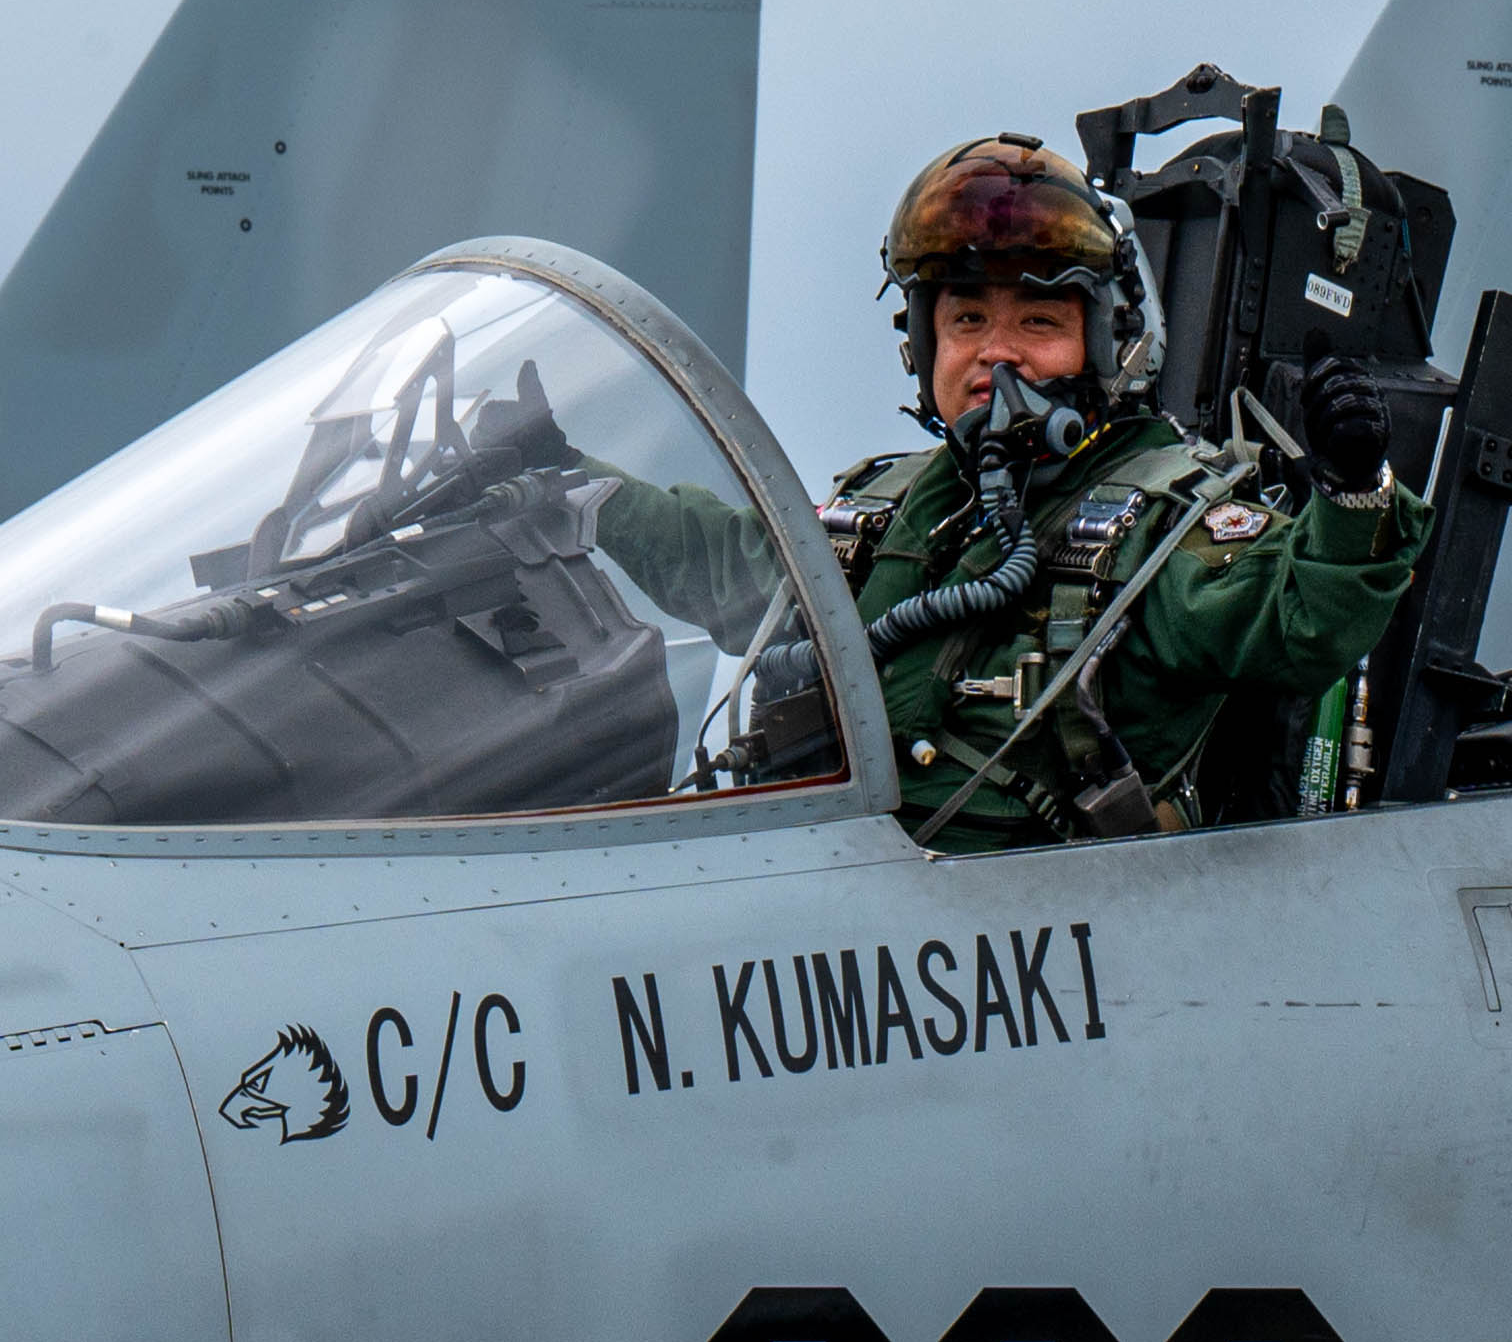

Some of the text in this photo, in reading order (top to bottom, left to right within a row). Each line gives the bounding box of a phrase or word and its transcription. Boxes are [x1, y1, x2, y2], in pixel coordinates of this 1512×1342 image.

[1308, 280, 1351, 309] 089FWD
[1310, 737, 1322, 783] OXYGEN
[366, 921, 1108, 1141] C/C N. KUMASAKI
